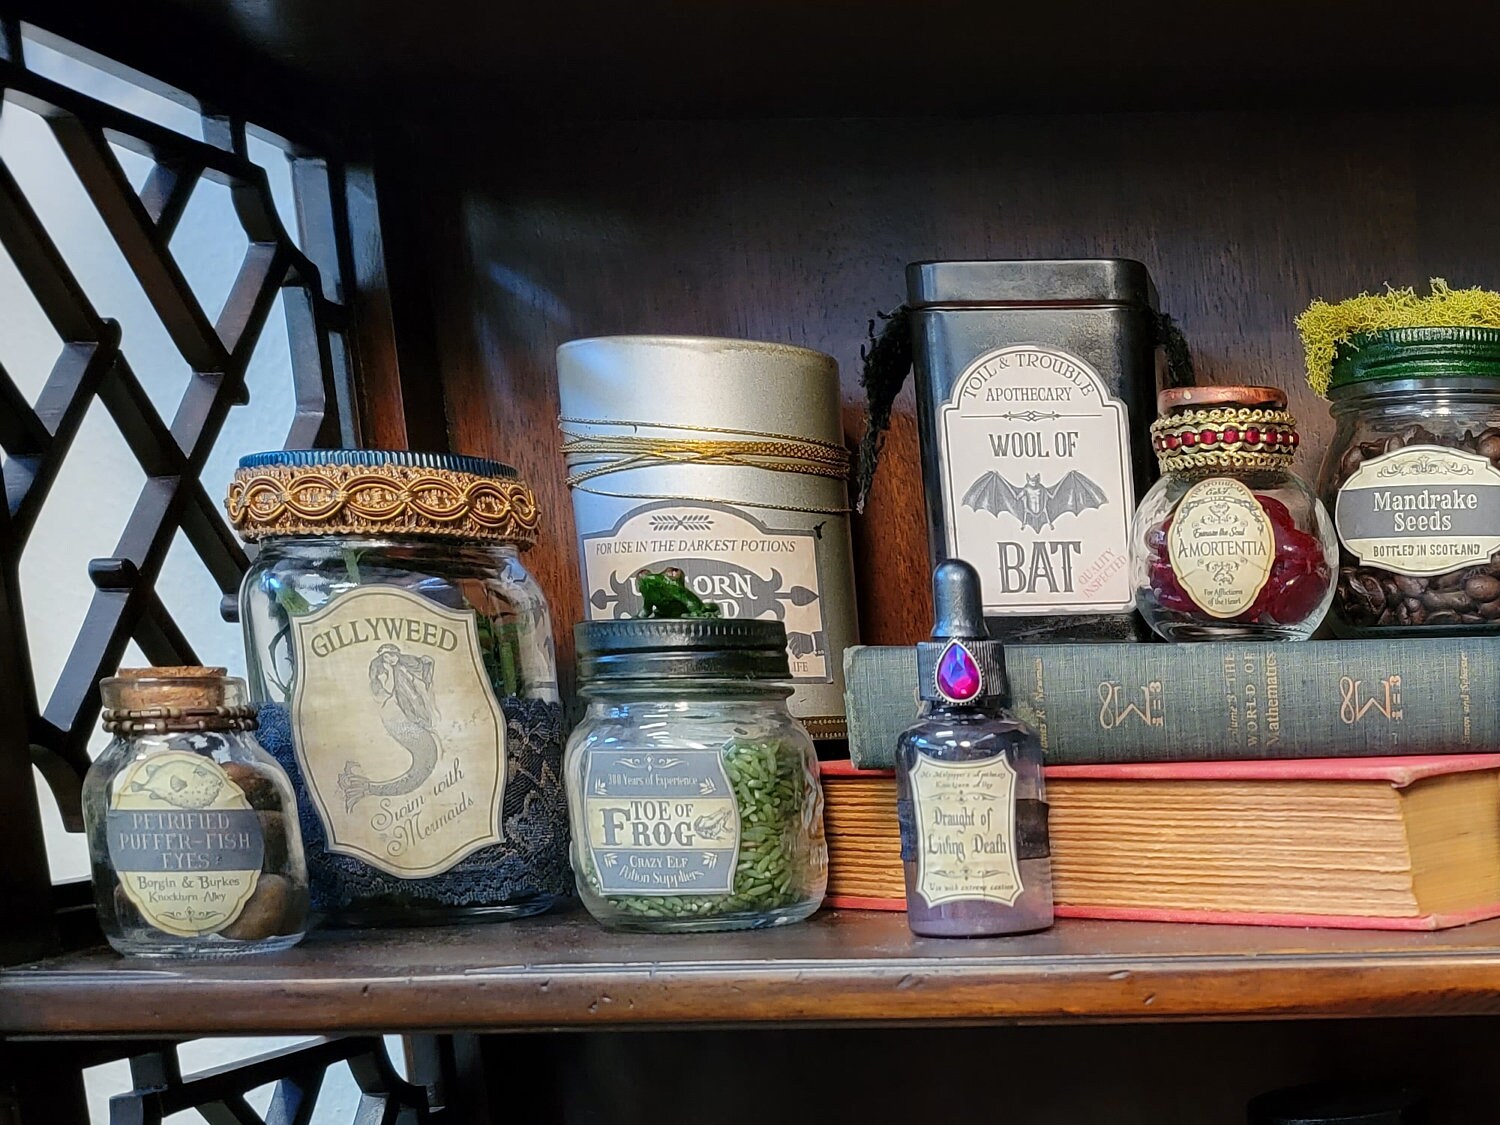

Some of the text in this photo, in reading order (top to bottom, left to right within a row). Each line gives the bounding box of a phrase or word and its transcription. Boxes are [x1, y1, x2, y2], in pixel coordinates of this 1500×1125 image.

[964, 354, 1095, 399] TOIL & TROUBLE
[986, 387, 1072, 402] APOTHECARY
[989, 431, 1079, 457] WOOL OF
[1373, 489, 1478, 512] Mandrake
[1394, 511, 1452, 532] Seeds
[596, 540, 796, 556] FOR USE IN THE DARKEST POTIONS
[1178, 539, 1266, 558] AMORTENTIA
[1373, 544, 1481, 558] BOTTLED IN SCOTLAND
[997, 541, 1081, 594] BAT
[1078, 547, 1116, 586] QUALITY
[1083, 554, 1128, 599] INSPECTED
[309, 617, 459, 660] GILLYWEED
[370, 757, 465, 833] Swim with
[132, 813, 230, 830] PETRIFIED
[630, 801, 694, 821] TOE OF
[933, 807, 993, 834] Draught of
[385, 793, 475, 858] Mermaids
[600, 808, 696, 846] FROG
[119, 832, 250, 850] PUFFER-FISH
[971, 833, 1007, 857] Death
[161, 852, 210, 869] EYES
[630, 855, 688, 868] CRAZY ELF
[137, 876, 240, 891] Borgin & Burkes
[653, 870, 704, 888] Suppliers
